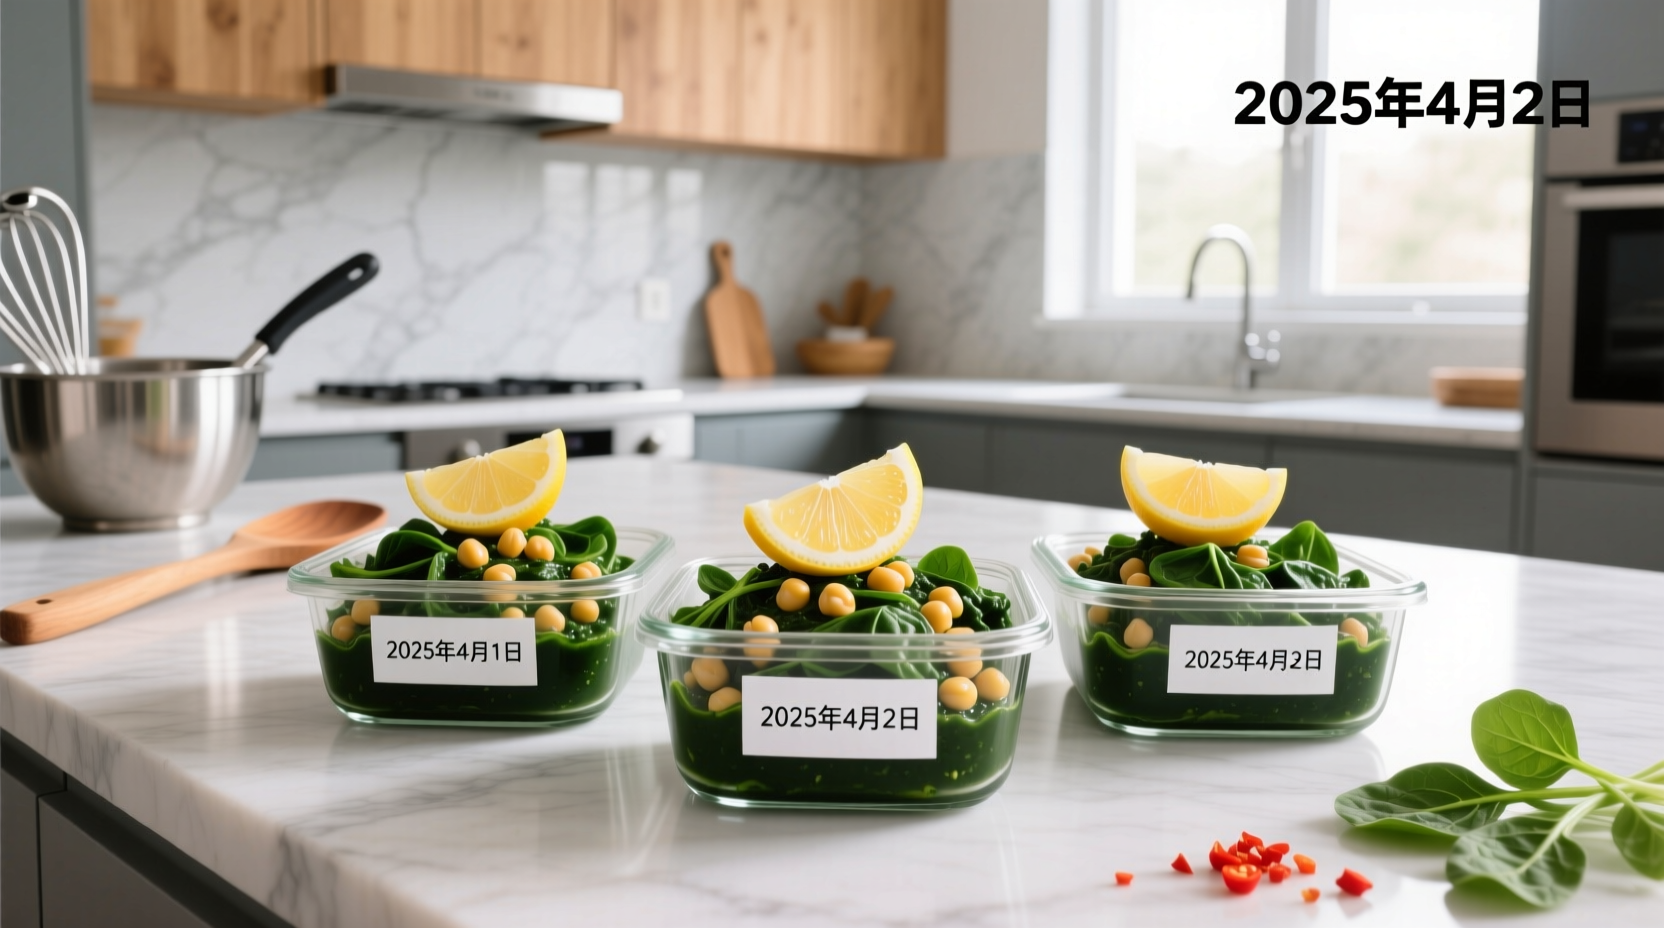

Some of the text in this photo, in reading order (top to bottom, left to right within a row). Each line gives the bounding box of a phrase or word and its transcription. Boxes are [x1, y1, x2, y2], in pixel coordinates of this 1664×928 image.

[386, 639, 521, 663] 2025年4月1日
[1184, 648, 1322, 672] 2025年4月2日
[761, 705, 918, 731] 2025年4月2日
